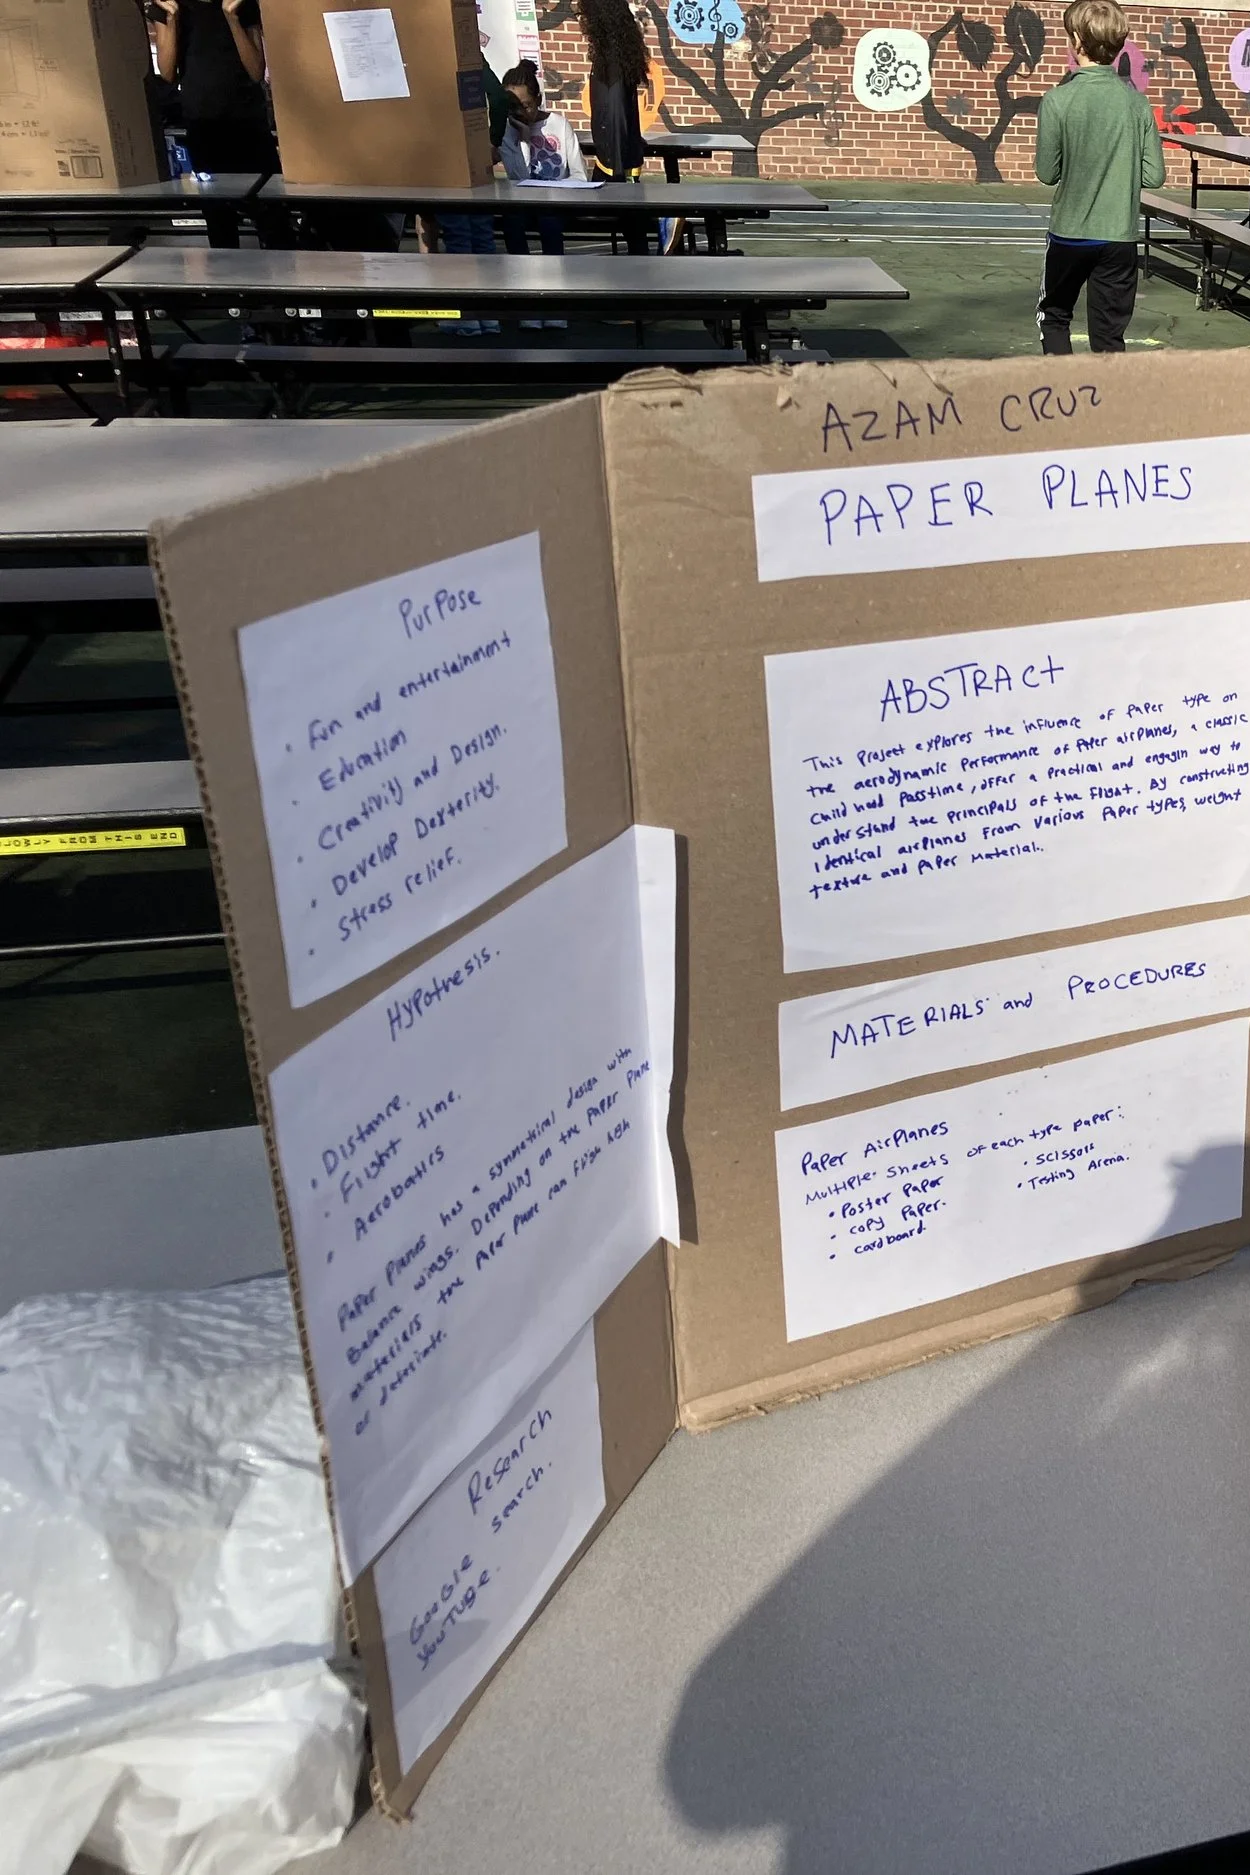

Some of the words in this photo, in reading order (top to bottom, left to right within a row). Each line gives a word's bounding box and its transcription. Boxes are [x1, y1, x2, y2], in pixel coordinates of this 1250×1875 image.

[822, 395, 962, 453] AZAM
[1000, 385, 1101, 432] CRUZ
[819, 481, 993, 546] PAPER
[1042, 462, 1191, 510] PLANES
[355, 691, 381, 720] and
[802, 756, 843, 771] This
[984, 724, 1014, 738] the
[1099, 709, 1115, 721] of
[1222, 692, 1237, 703] on
[413, 755, 439, 788] and
[806, 783, 836, 798] the
[854, 761, 947, 790] aerodynamic
[1054, 744, 1070, 756] of
[1205, 714, 1248, 729] classic
[1029, 774, 1037, 782] a
[1112, 755, 1133, 771] and
[1199, 744, 1220, 756] way
[1230, 740, 1241, 751] to
[908, 816, 938, 827] the
[1029, 795, 1048, 807] of
[1054, 792, 1083, 803] the
[1150, 776, 1166, 791] By
[59, 836, 97, 844] FROM
[104, 834, 142, 842] THIS
[150, 832, 178, 841] END
[881, 863, 908, 879] and
[338, 892, 392, 942] Stress
[1003, 992, 1032, 1010] and
[1068, 962, 1206, 1000] PROCEDURES
[991, 1137, 1024, 1150] each
[1029, 1124, 1062, 1140] type
[539, 1147, 552, 1166] on
[1028, 1168, 1075, 1190] Testing
[440, 1200, 463, 1227] has
